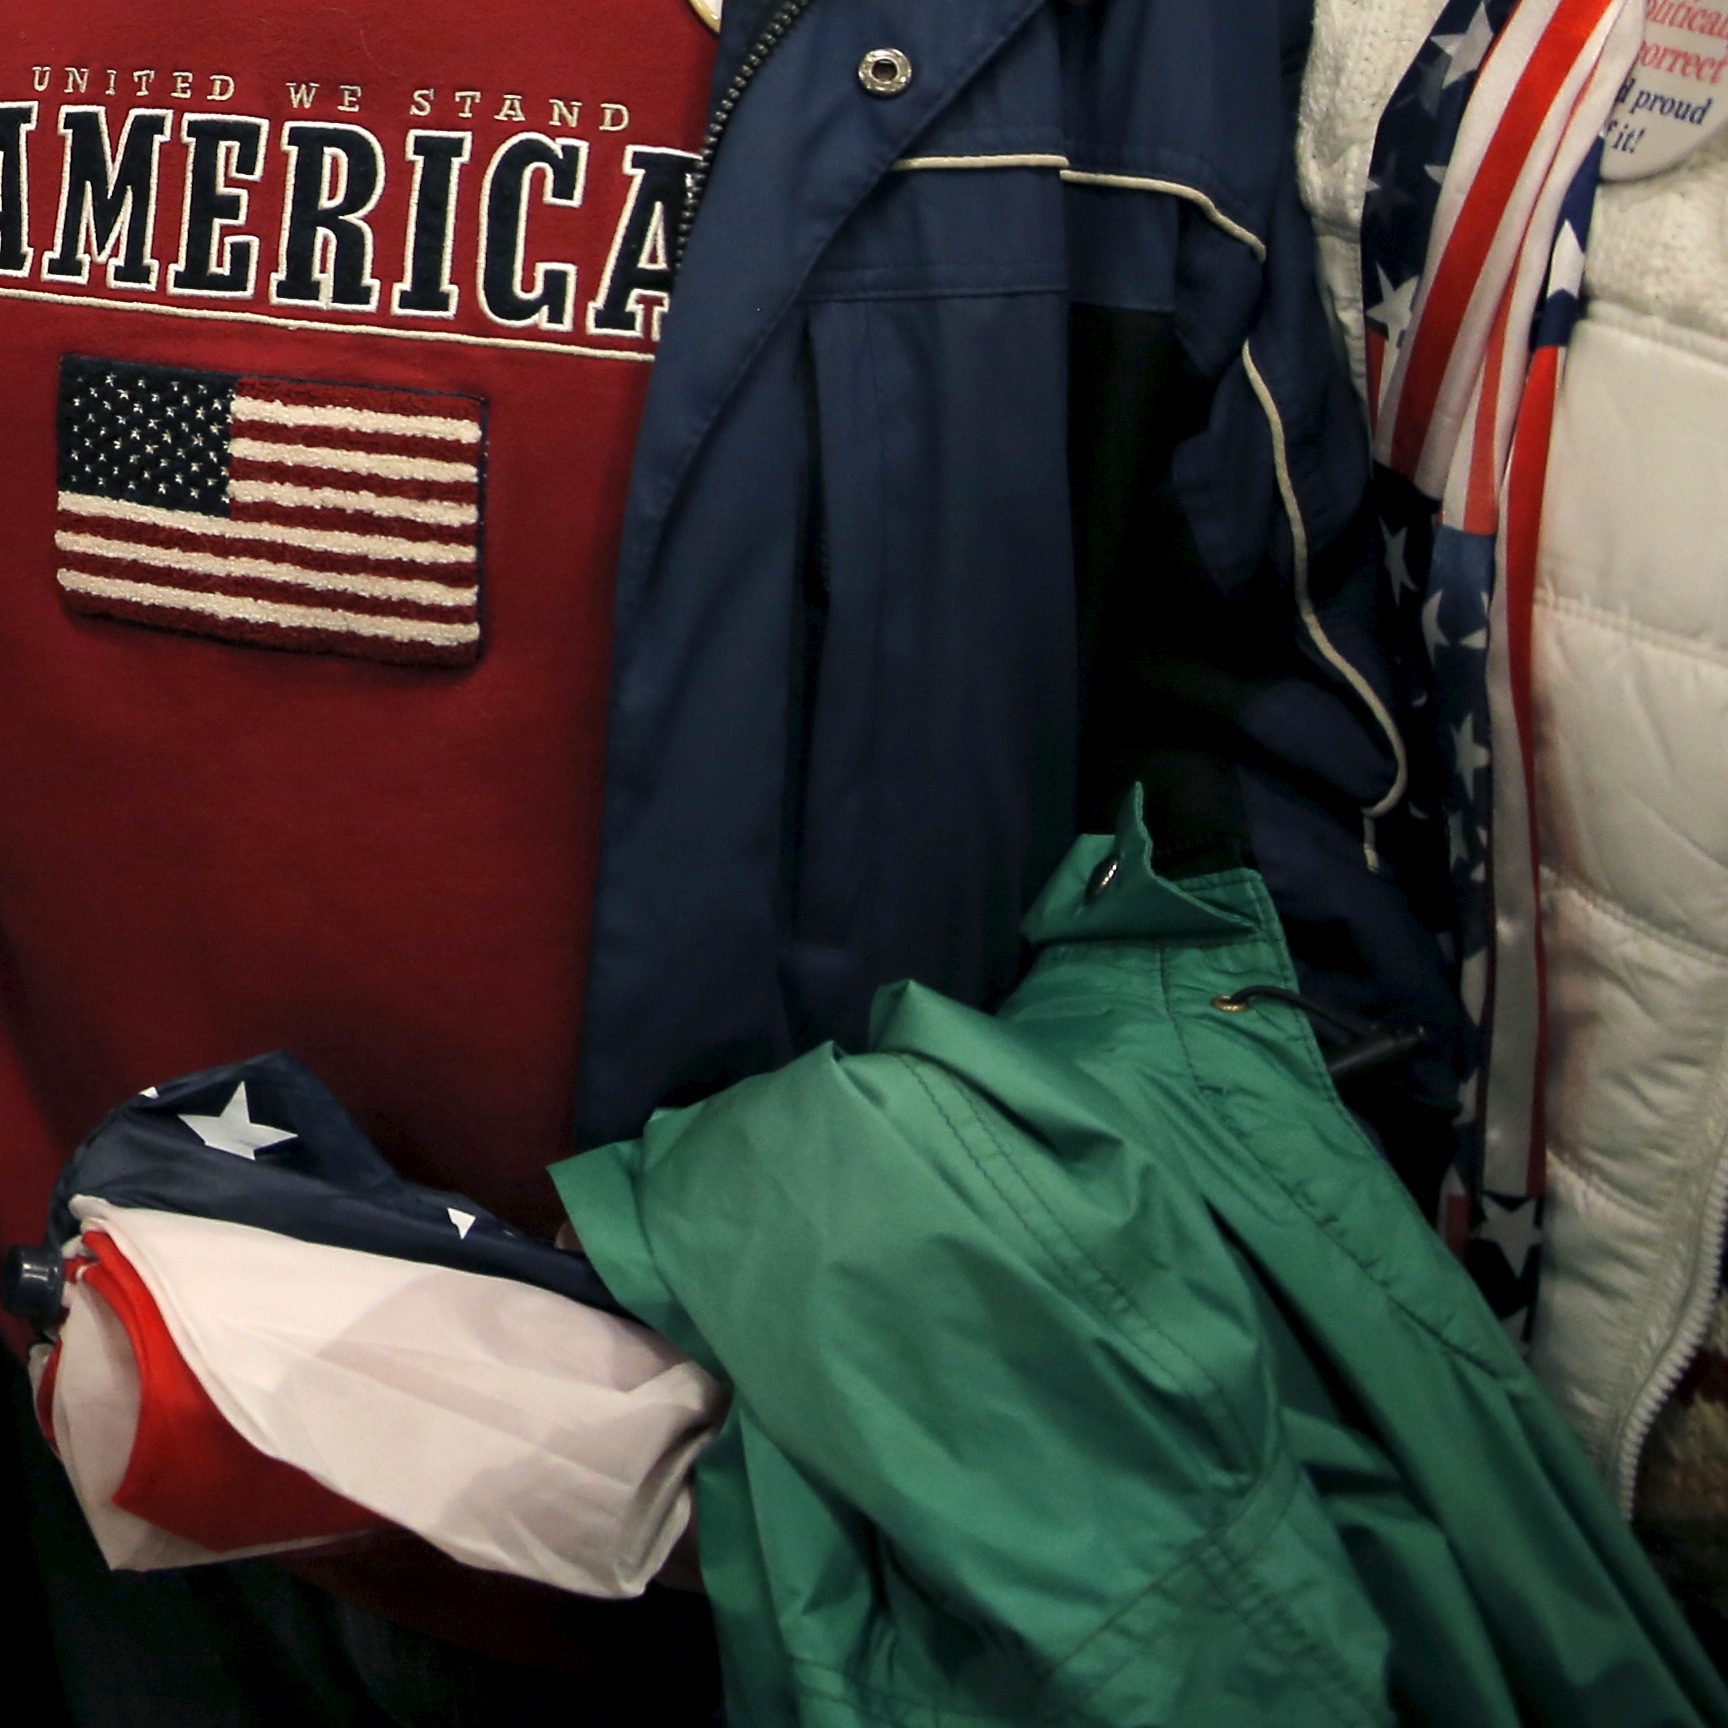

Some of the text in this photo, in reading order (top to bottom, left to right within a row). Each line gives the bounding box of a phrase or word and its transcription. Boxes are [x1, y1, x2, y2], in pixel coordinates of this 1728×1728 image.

[31, 65, 631, 133] UNITED WE STAND
[1628, 89, 1713, 125] proud
[1611, 123, 1646, 154] it!
